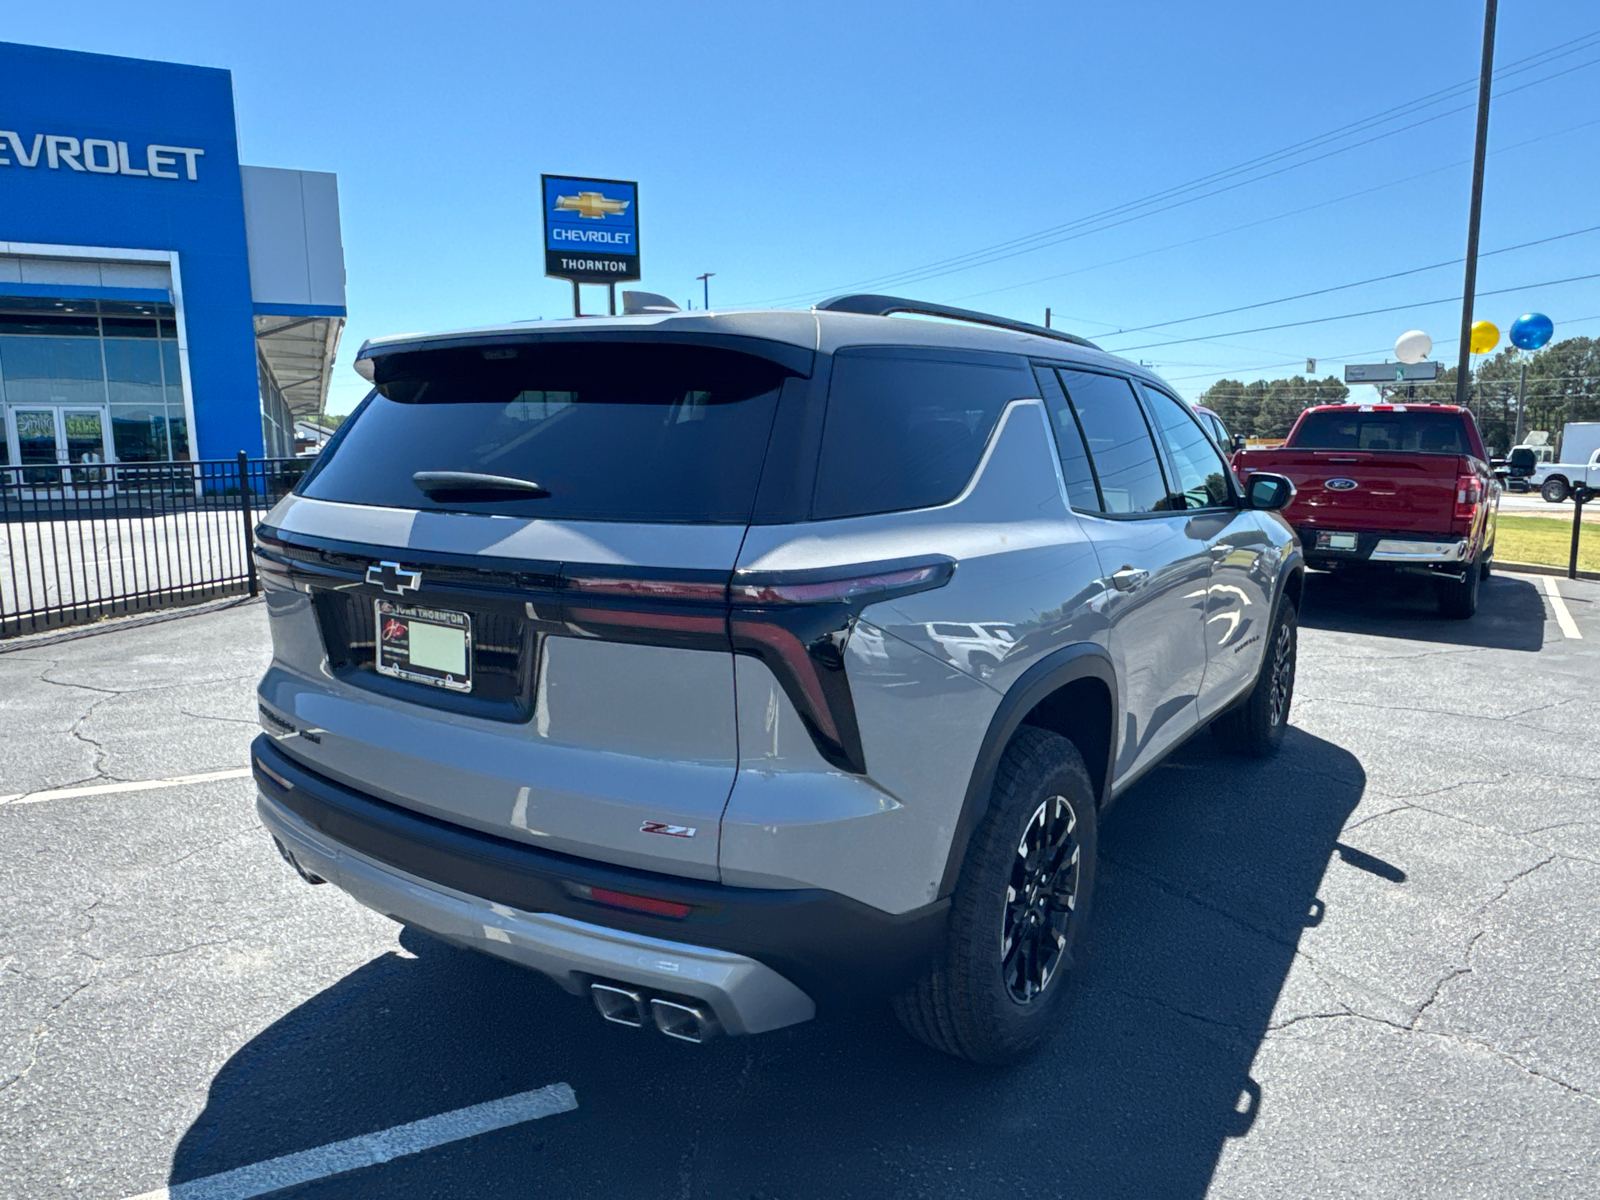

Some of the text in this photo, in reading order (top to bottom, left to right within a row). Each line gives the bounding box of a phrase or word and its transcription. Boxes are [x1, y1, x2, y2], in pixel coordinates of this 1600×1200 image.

[553, 228, 631, 244] CHEVROLET
[561, 258, 627, 272] THORNTON
[417, 608, 464, 625] THORNTON
[639, 820, 697, 839] Z71
